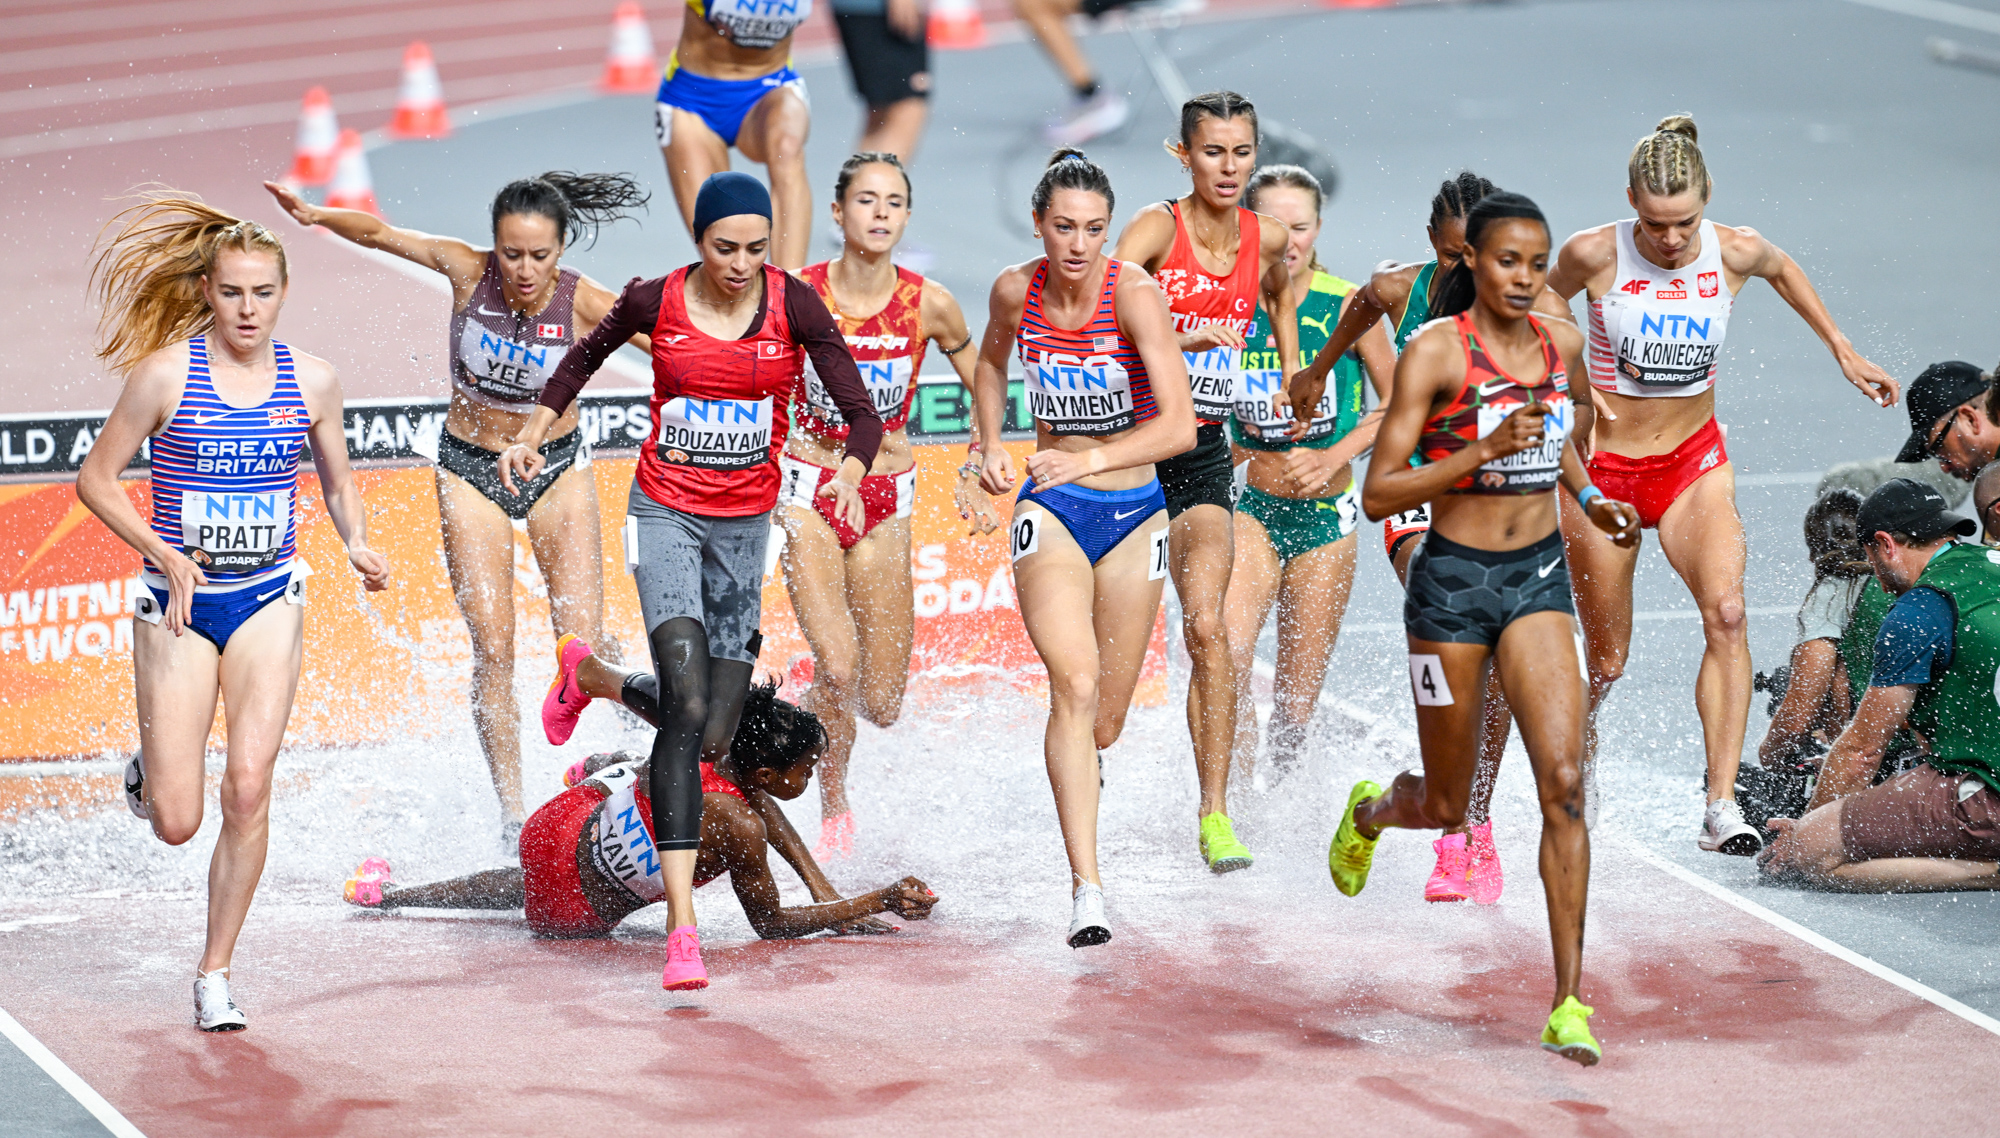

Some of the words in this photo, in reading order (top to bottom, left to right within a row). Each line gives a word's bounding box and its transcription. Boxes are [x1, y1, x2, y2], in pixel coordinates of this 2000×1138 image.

[737, 0, 798, 16] NTN
[1621, 279, 1651, 295] 4F
[1658, 291, 1686, 299] ORLEN
[1640, 311, 1711, 341] NTN
[480, 330, 547, 368] NTN
[843, 335, 909, 350] PAÑA
[1641, 341, 1719, 367] KONIECZEK
[487, 358, 531, 386] YEE
[1038, 366, 1108, 391] NTN
[1245, 372, 1282, 395] NT
[1189, 374, 1233, 402] VENÇ
[684, 397, 759, 425] NTN
[1030, 390, 1124, 417] WAYMENT
[198, 440, 293, 457] GREAT
[665, 424, 767, 451] BOUZAYANI
[196, 458, 291, 474] BRITAIN
[1699, 443, 1720, 470] 4F
[206, 493, 275, 520] NTN
[200, 525, 276, 549] PRATT
[1013, 518, 1033, 557] 10
[1421, 664, 1437, 699] 4
[602, 824, 639, 882] YAVI
[617, 805, 661, 877] NTN
